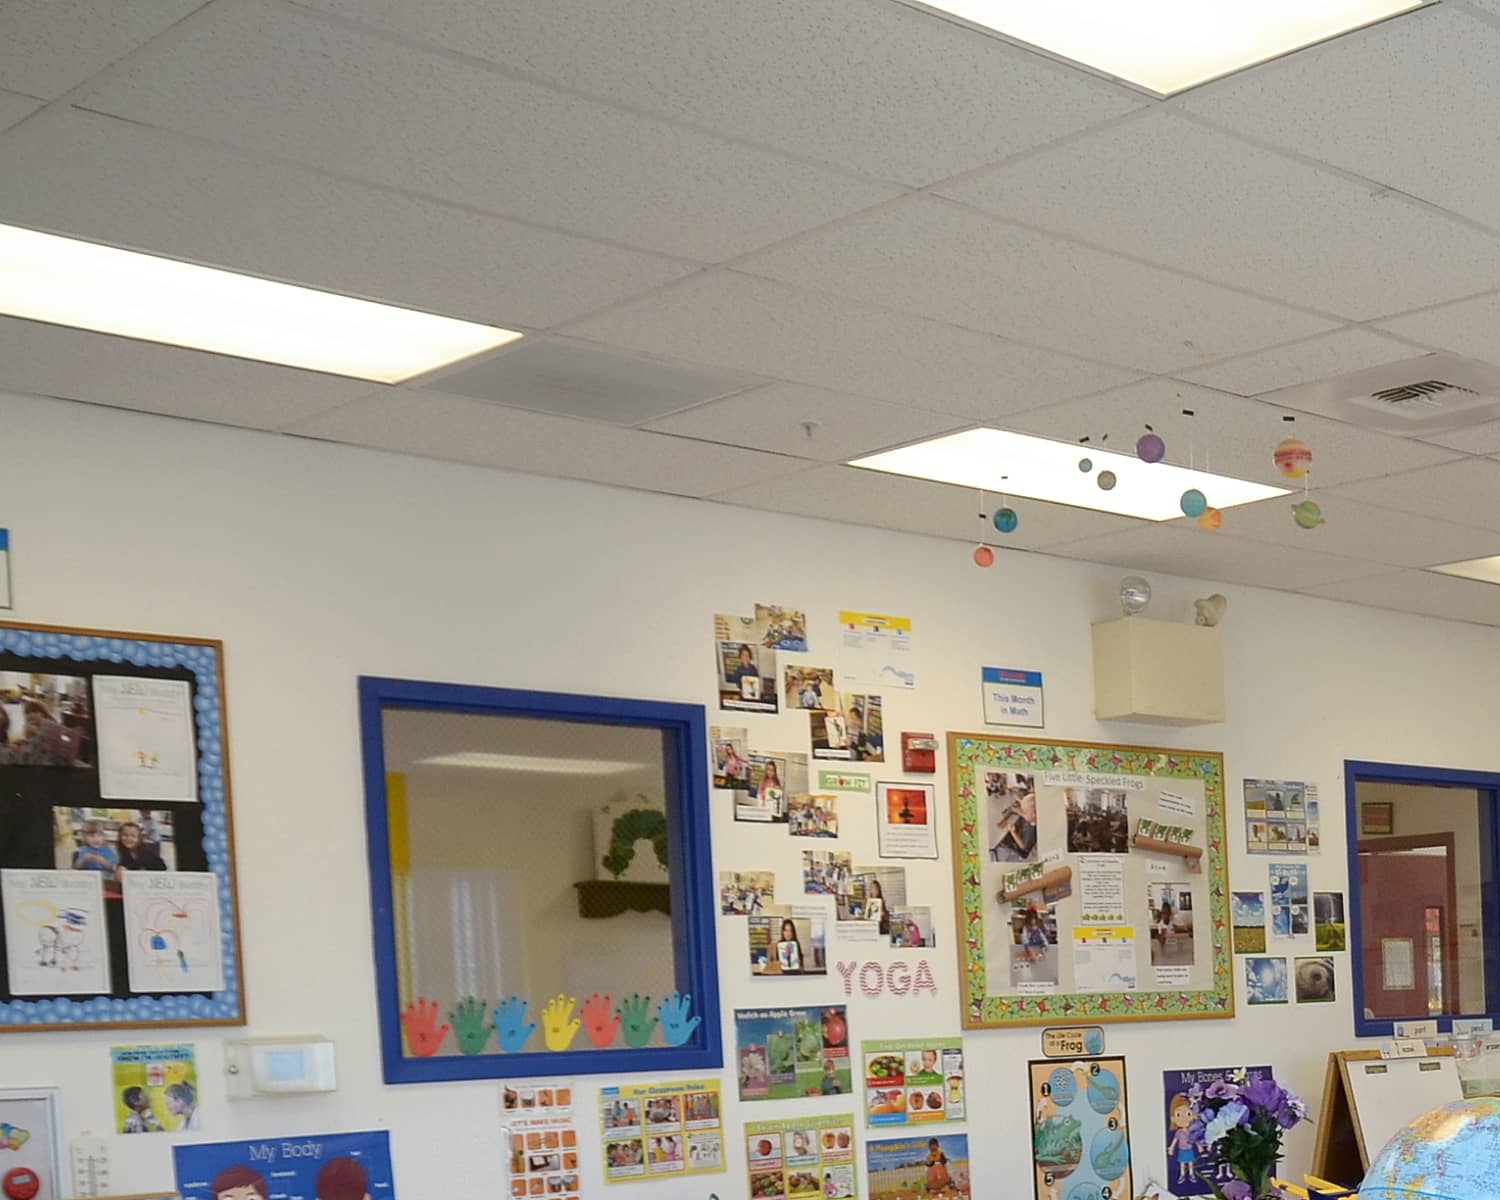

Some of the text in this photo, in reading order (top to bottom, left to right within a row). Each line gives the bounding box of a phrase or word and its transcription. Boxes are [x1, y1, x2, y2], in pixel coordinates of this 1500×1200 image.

[992, 693, 1035, 705] This Month
[1010, 707, 1029, 716] Math
[1044, 772, 1143, 791] Five Little Speckled Frogs
[836, 959, 937, 997] YOGA
[1061, 1040, 1083, 1053] Frog
[1181, 1071, 1195, 1085] My
[1197, 1071, 1223, 1083] Bones
[250, 1140, 323, 1163] My Body
